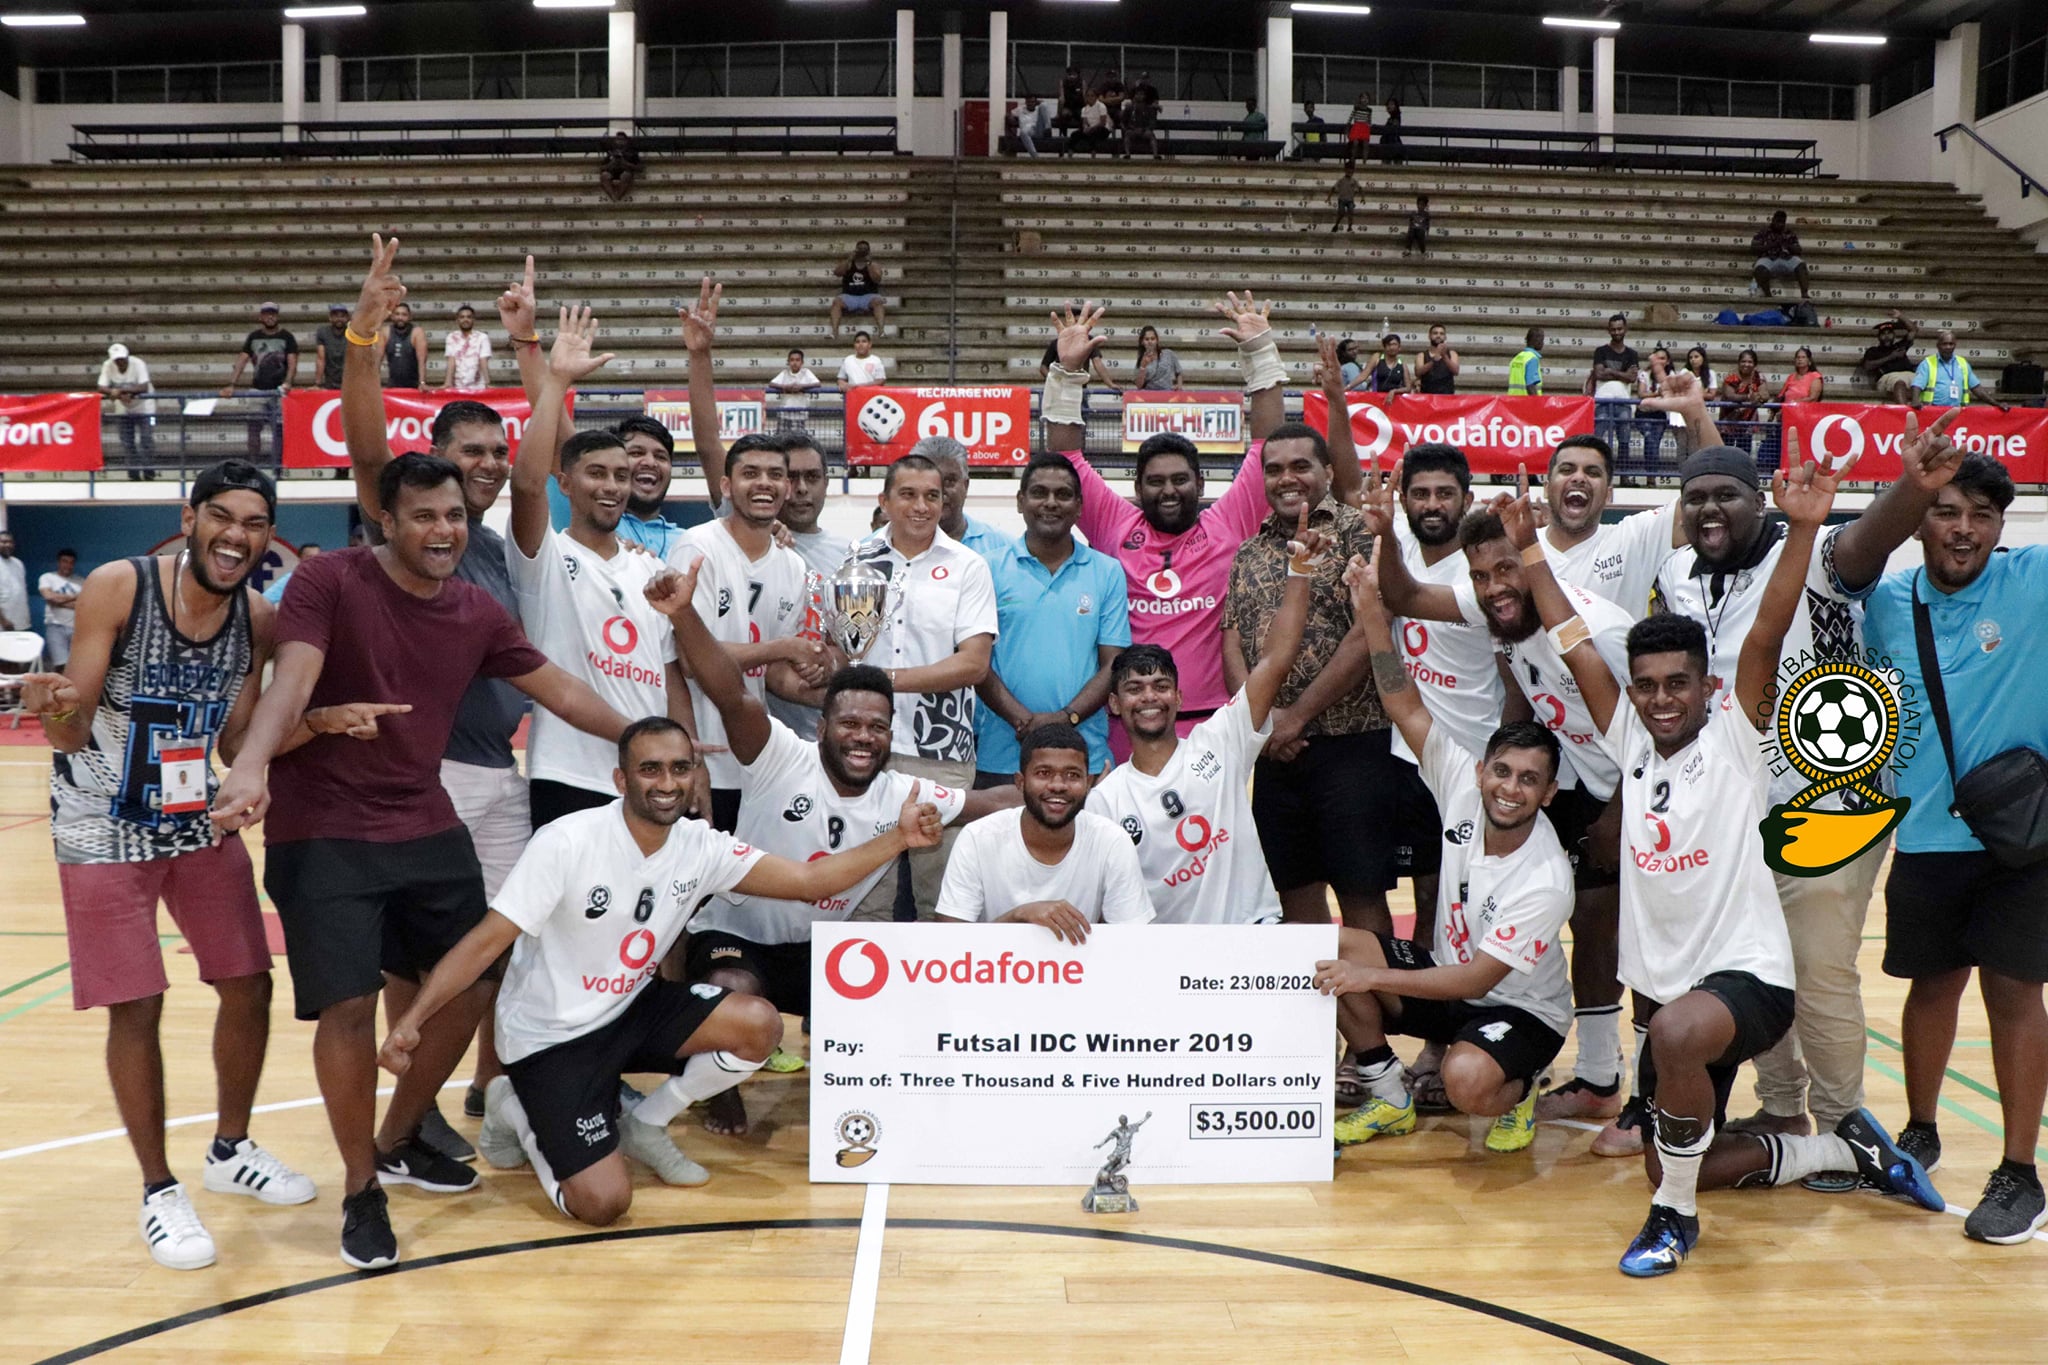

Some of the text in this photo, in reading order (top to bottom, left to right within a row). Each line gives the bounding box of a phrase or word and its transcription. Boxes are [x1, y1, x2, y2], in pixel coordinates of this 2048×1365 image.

[1305, 222, 1318, 230] 47
[1094, 244, 1106, 253] 39
[1125, 245, 1137, 253] 40
[1260, 247, 1271, 255] 45
[1313, 248, 1325, 256] 47
[1383, 275, 1949, 301] 49 50 51 52 59 60 70
[1015, 297, 1714, 321] 36 37 38 39 40 41 45 46 47 49 50 51 52 53 54 55 56 60
[1018, 326, 1030, 335] 36
[1038, 326, 1050, 335] 37
[1130, 327, 1143, 336] 40
[1282, 330, 1295, 338] 45
[1340, 331, 1354, 341] 47
[1571, 337, 1584, 346] 55
[1773, 343, 1785, 352] 62
[1821, 345, 1833, 353] 64
[1915, 348, 1927, 356] 67
[1969, 349, 1981, 357] 69
[1996, 349, 2008, 357] 70
[1106, 359, 1307, 370] 39 45
[917, 387, 1013, 399] RECHARGE NOW
[725, 407, 758, 432] FM
[1129, 407, 1236, 434] MIRCHI FM
[1402, 416, 1566, 448] vodafone
[1872, 427, 2027, 457] vofone
[972, 450, 1000, 460] above
[1593, 552, 1623, 574] Suva
[1599, 565, 1624, 584] Futsal
[748, 582, 763, 614] 7
[1126, 593, 1216, 616] vodafone
[1190, 749, 1216, 778] Suva
[1160, 788, 1185, 819] 9
[1651, 780, 1671, 813] 2
[633, 886, 656, 924] 6
[901, 951, 1084, 985] vodafone
[1180, 975, 1225, 990] Date:
[937, 1033, 1254, 1053] Futsal IDC Winner 2019
[1478, 1020, 1513, 1043] 4
[824, 1039, 864, 1056] Pay:
[823, 1072, 1321, 1091] Sum of: Three Thousand & Five Hundred Dollars only
[576, 1112, 607, 1137] Suva
[1196, 1108, 1315, 1134] $3,500.00
